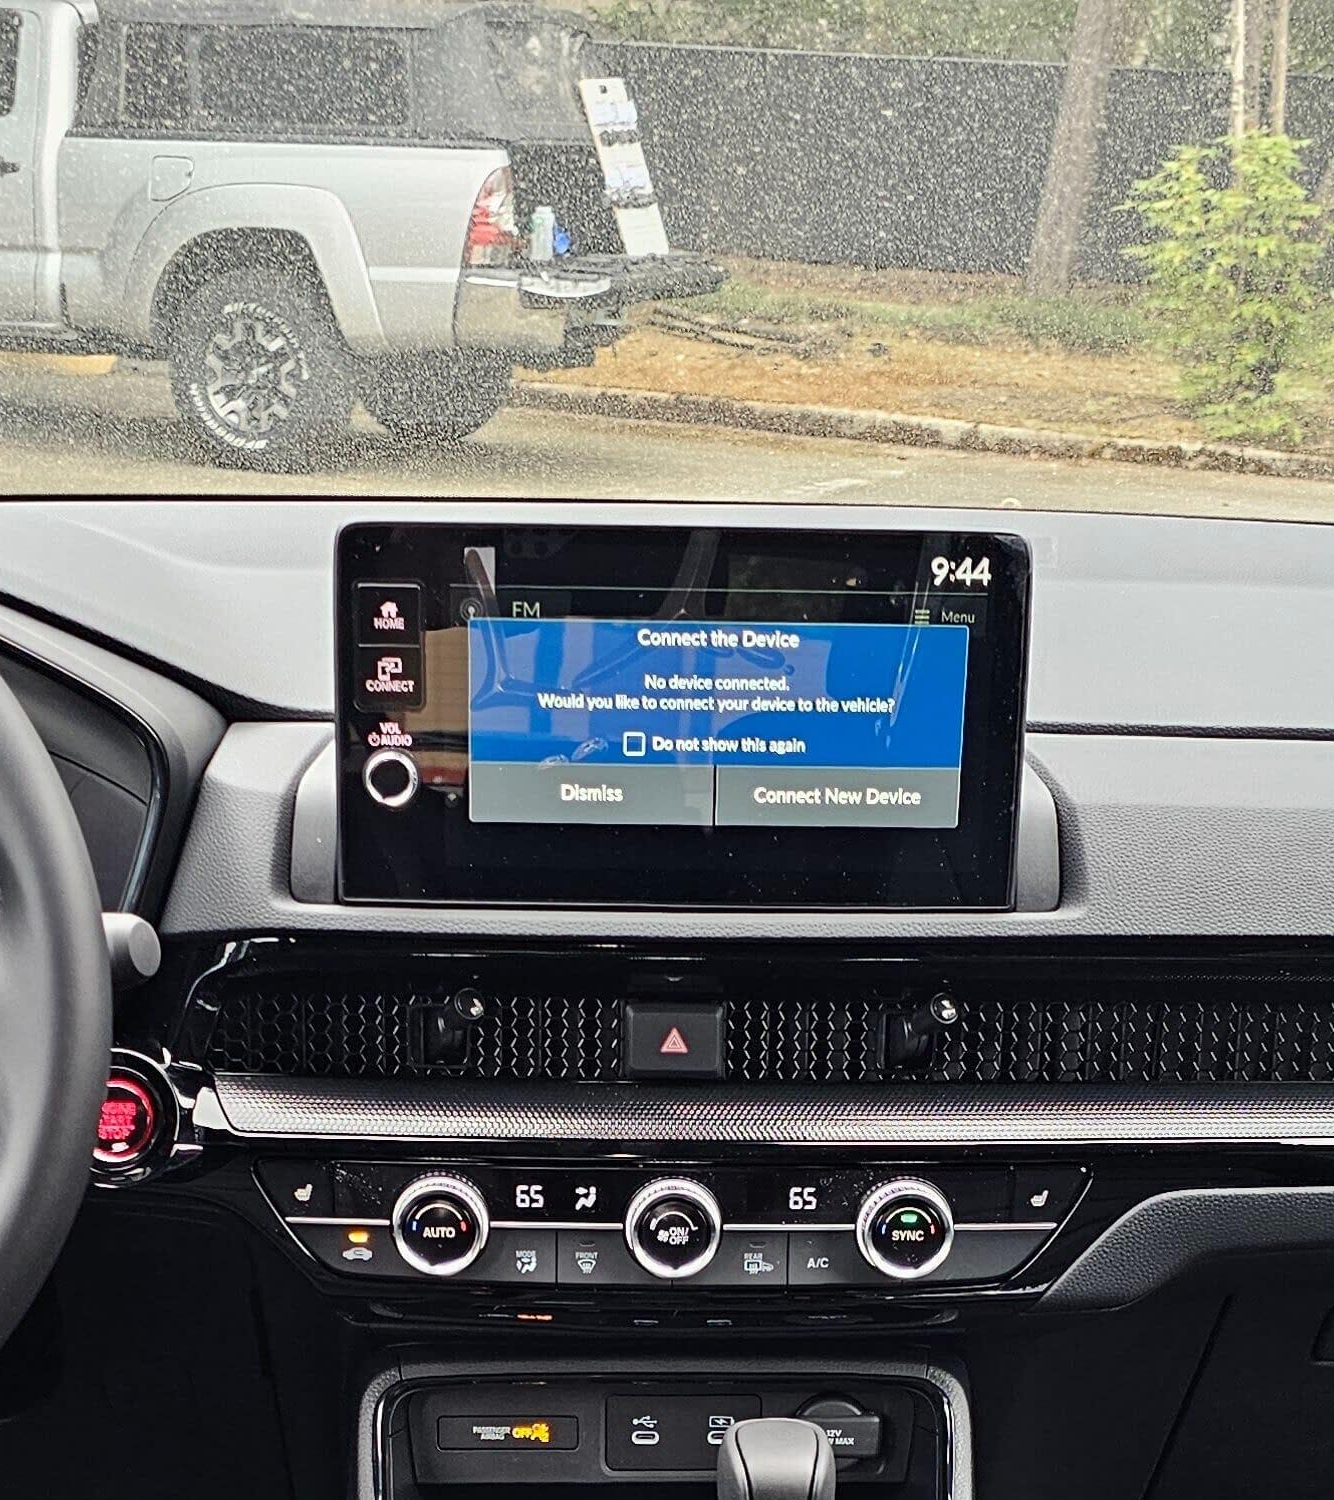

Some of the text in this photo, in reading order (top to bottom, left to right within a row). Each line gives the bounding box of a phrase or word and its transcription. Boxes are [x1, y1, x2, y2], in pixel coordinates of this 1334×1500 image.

[931, 556, 992, 587] 9:44
[512, 601, 540, 618] FM
[941, 610, 975, 624] Menu
[373, 617, 405, 630] HOME
[637, 628, 800, 648] Connect the Device
[365, 679, 414, 693] CONNECT
[644, 674, 790, 691] No device connected.
[537, 693, 895, 714] Would you like to connect your device to the vehicle?
[379, 722, 402, 734] VOL
[381, 734, 412, 747] AUDIO
[652, 736, 806, 755] Do not show this again
[561, 783, 624, 802] Dismiss
[754, 786, 921, 805] Connect New Device
[516, 1185, 544, 1208] 65
[789, 1187, 817, 1210] 65
[422, 1226, 455, 1239] AUTO
[892, 1230, 924, 1242] SYNC
[575, 1252, 598, 1260] FRONT
[807, 1257, 829, 1269] A/C
[835, 1437, 855, 1446] MAX
